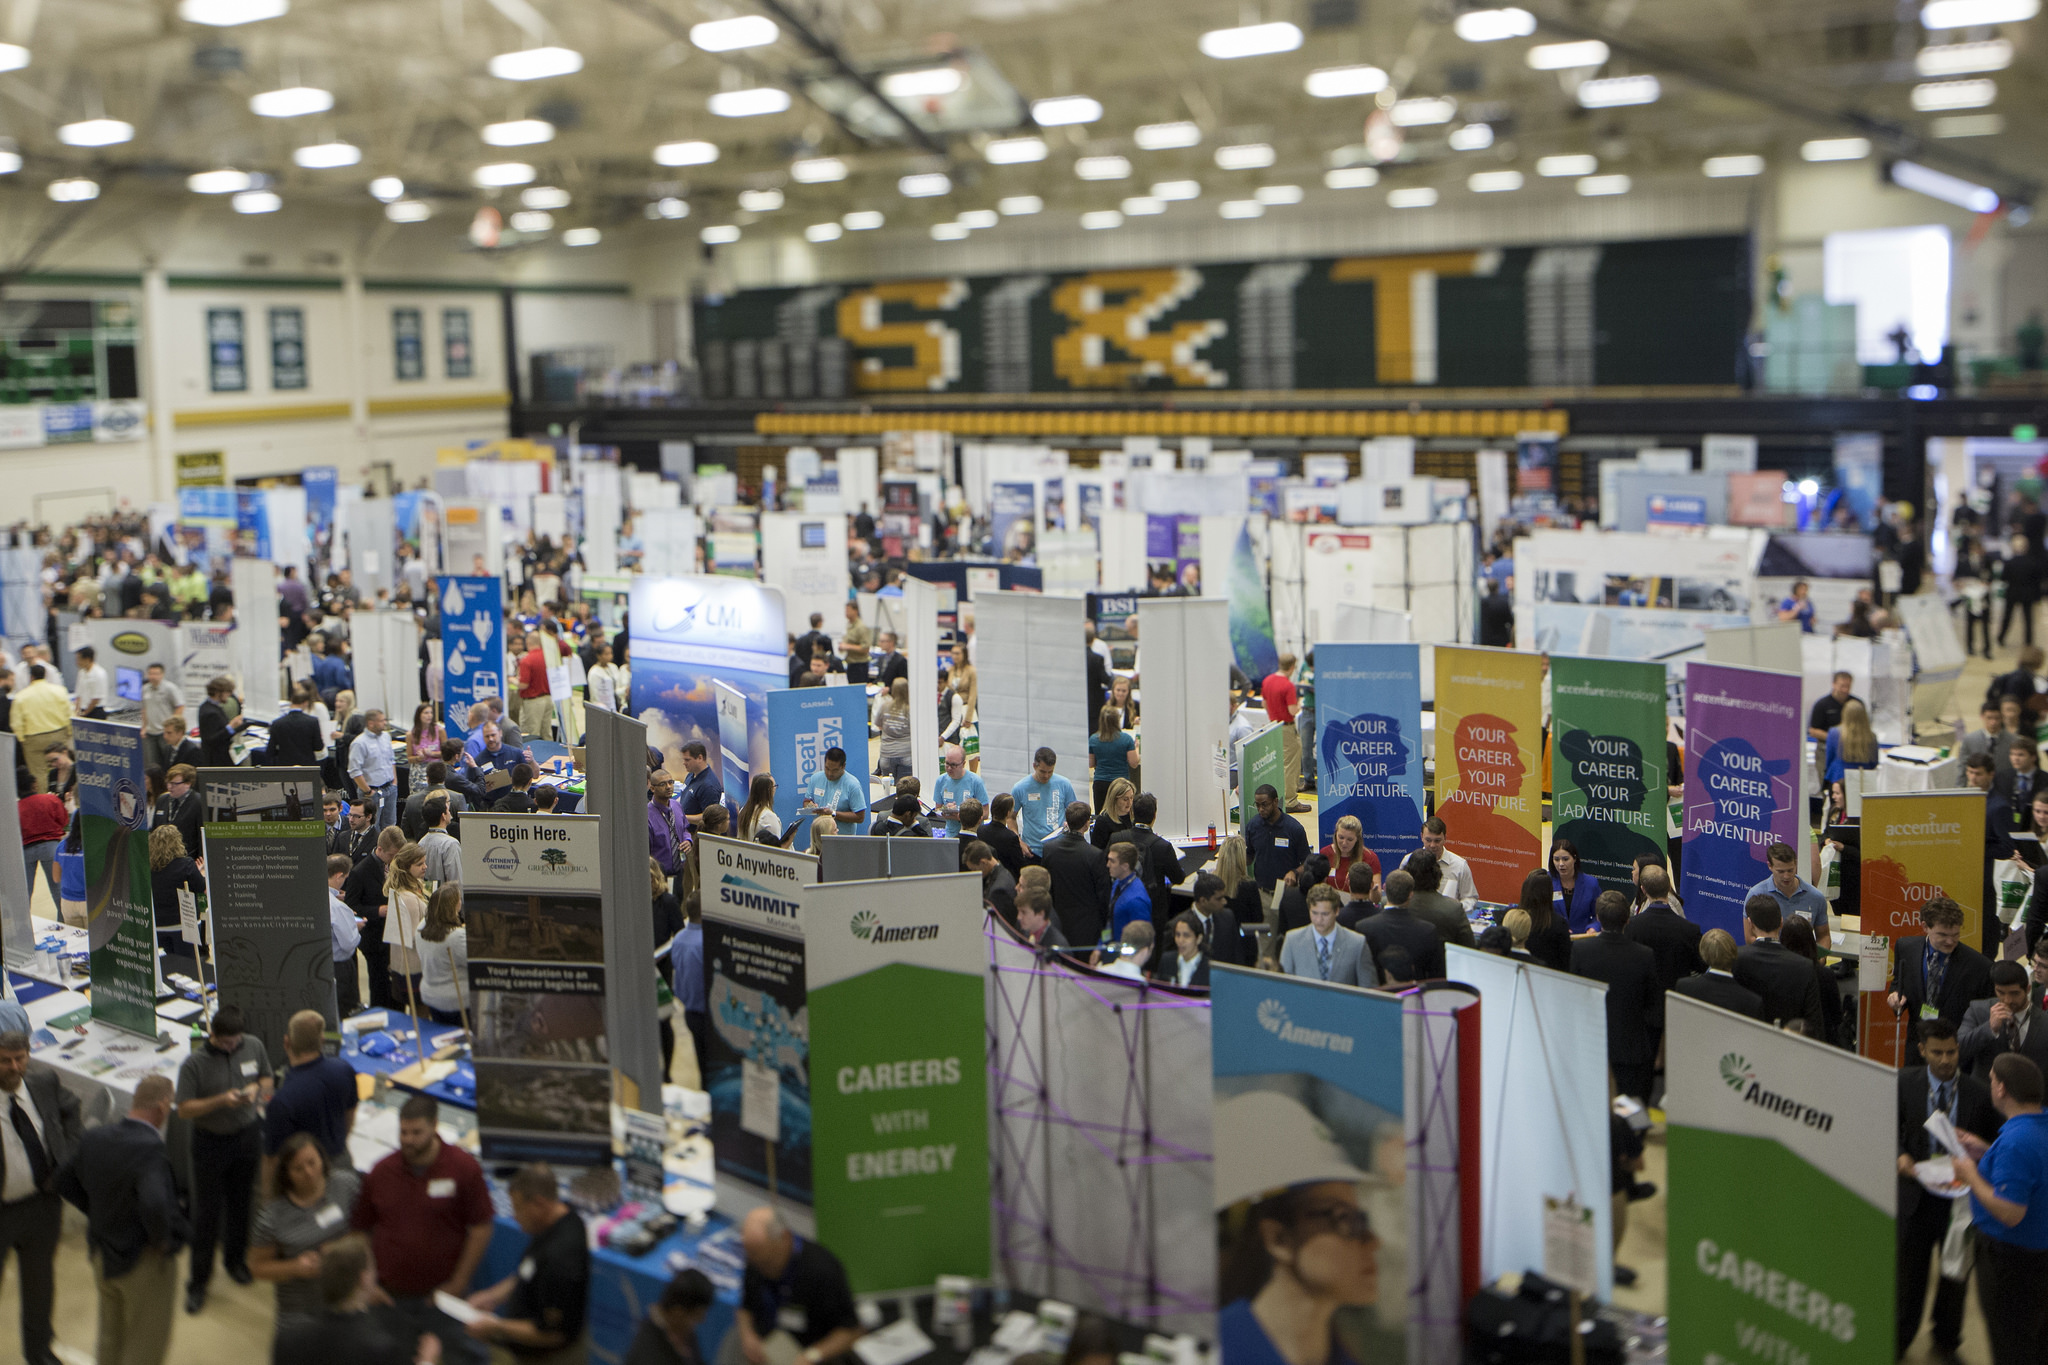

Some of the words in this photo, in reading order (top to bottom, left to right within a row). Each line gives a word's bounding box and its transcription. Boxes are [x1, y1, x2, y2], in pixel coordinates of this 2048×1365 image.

[837, 279, 969, 391] S
[1052, 265, 1228, 387] &
[1328, 249, 1502, 385] T
[1103, 598, 1134, 613] BSI
[706, 604, 742, 629] LMI
[801, 700, 834, 709] GARMIN
[1349, 720, 1388, 734] YOUR
[1467, 726, 1506, 744] YOUR
[88, 730, 109, 746] sure
[109, 733, 138, 750] where
[1341, 741, 1397, 755] CAREER.
[1587, 739, 1629, 757] YOUR
[94, 753, 121, 768] career
[122, 753, 130, 769] is
[1252, 750, 1277, 773] accenture
[1459, 747, 1516, 766] CAREER.
[1720, 751, 1763, 773] YOUR
[1351, 763, 1388, 776] YOUR
[1467, 769, 1506, 787] YOUR
[1578, 760, 1640, 781] CAREER.
[1328, 783, 1412, 798] ADVENTURE.
[1588, 783, 1629, 802] YOUR
[1710, 773, 1772, 799] CAREER.
[1445, 788, 1530, 813] ADVENTURE.
[1719, 798, 1761, 821] YOUR
[1563, 803, 1655, 828] ADVENTURE.
[490, 824, 529, 843] Begin
[533, 825, 571, 841] Here.
[1885, 821, 1961, 836] accenture
[1458, 840, 1477, 849] Consulting
[1516, 848, 1536, 856] Operations
[528, 864, 552, 872] GREEN
[556, 864, 588, 873] AMERICA
[717, 849, 732, 867] Go
[736, 853, 799, 881] Anywhere.
[1600, 859, 1613, 867] Digital
[1686, 871, 1703, 880] Strategy
[1705, 874, 1725, 885] Consulting
[1728, 879, 1741, 888] Digital
[1698, 889, 1745, 905] careers.accenture.co
[1901, 885, 1943, 901] YOUR
[112, 898, 124, 908] Let
[124, 901, 133, 910] us
[133, 902, 149, 914] help
[720, 887, 800, 919] SUMMIT
[106, 910, 122, 919] pave
[123, 912, 135, 922] the
[135, 917, 150, 928] way
[767, 917, 801, 931] Materials
[117, 932, 134, 948] Bring
[135, 939, 151, 950] your
[871, 924, 939, 944] Ameren
[105, 943, 138, 957] education
[138, 952, 151, 962] and
[722, 934, 732, 945] At
[732, 937, 763, 953] Summit
[763, 945, 803, 964] Materials
[116, 958, 152, 975] experience
[731, 950, 750, 962] your
[750, 954, 777, 968] career
[777, 961, 793, 974] can
[487, 966, 510, 976] Your
[510, 967, 562, 978] foundation
[563, 969, 574, 979] to
[575, 970, 588, 979] an
[735, 963, 746, 975] go
[746, 965, 789, 985] anywhere.
[113, 976, 128, 988] We'll
[128, 980, 141, 994] help
[142, 986, 153, 997] you
[475, 978, 512, 989] exciting
[513, 979, 542, 988] career
[545, 980, 575, 992] begins
[576, 981, 601, 991] here.
[103, 985, 113, 995] the
[114, 989, 127, 1002] right
[128, 992, 154, 1009] direction
[1279, 1021, 1354, 1054] Ameren
[837, 1056, 961, 1094] CAREERS
[1744, 1081, 1833, 1133] Ameren
[871, 1109, 929, 1135] WITH
[846, 1143, 957, 1182] ENERGY
[1697, 1238, 1856, 1343] CAREERS
